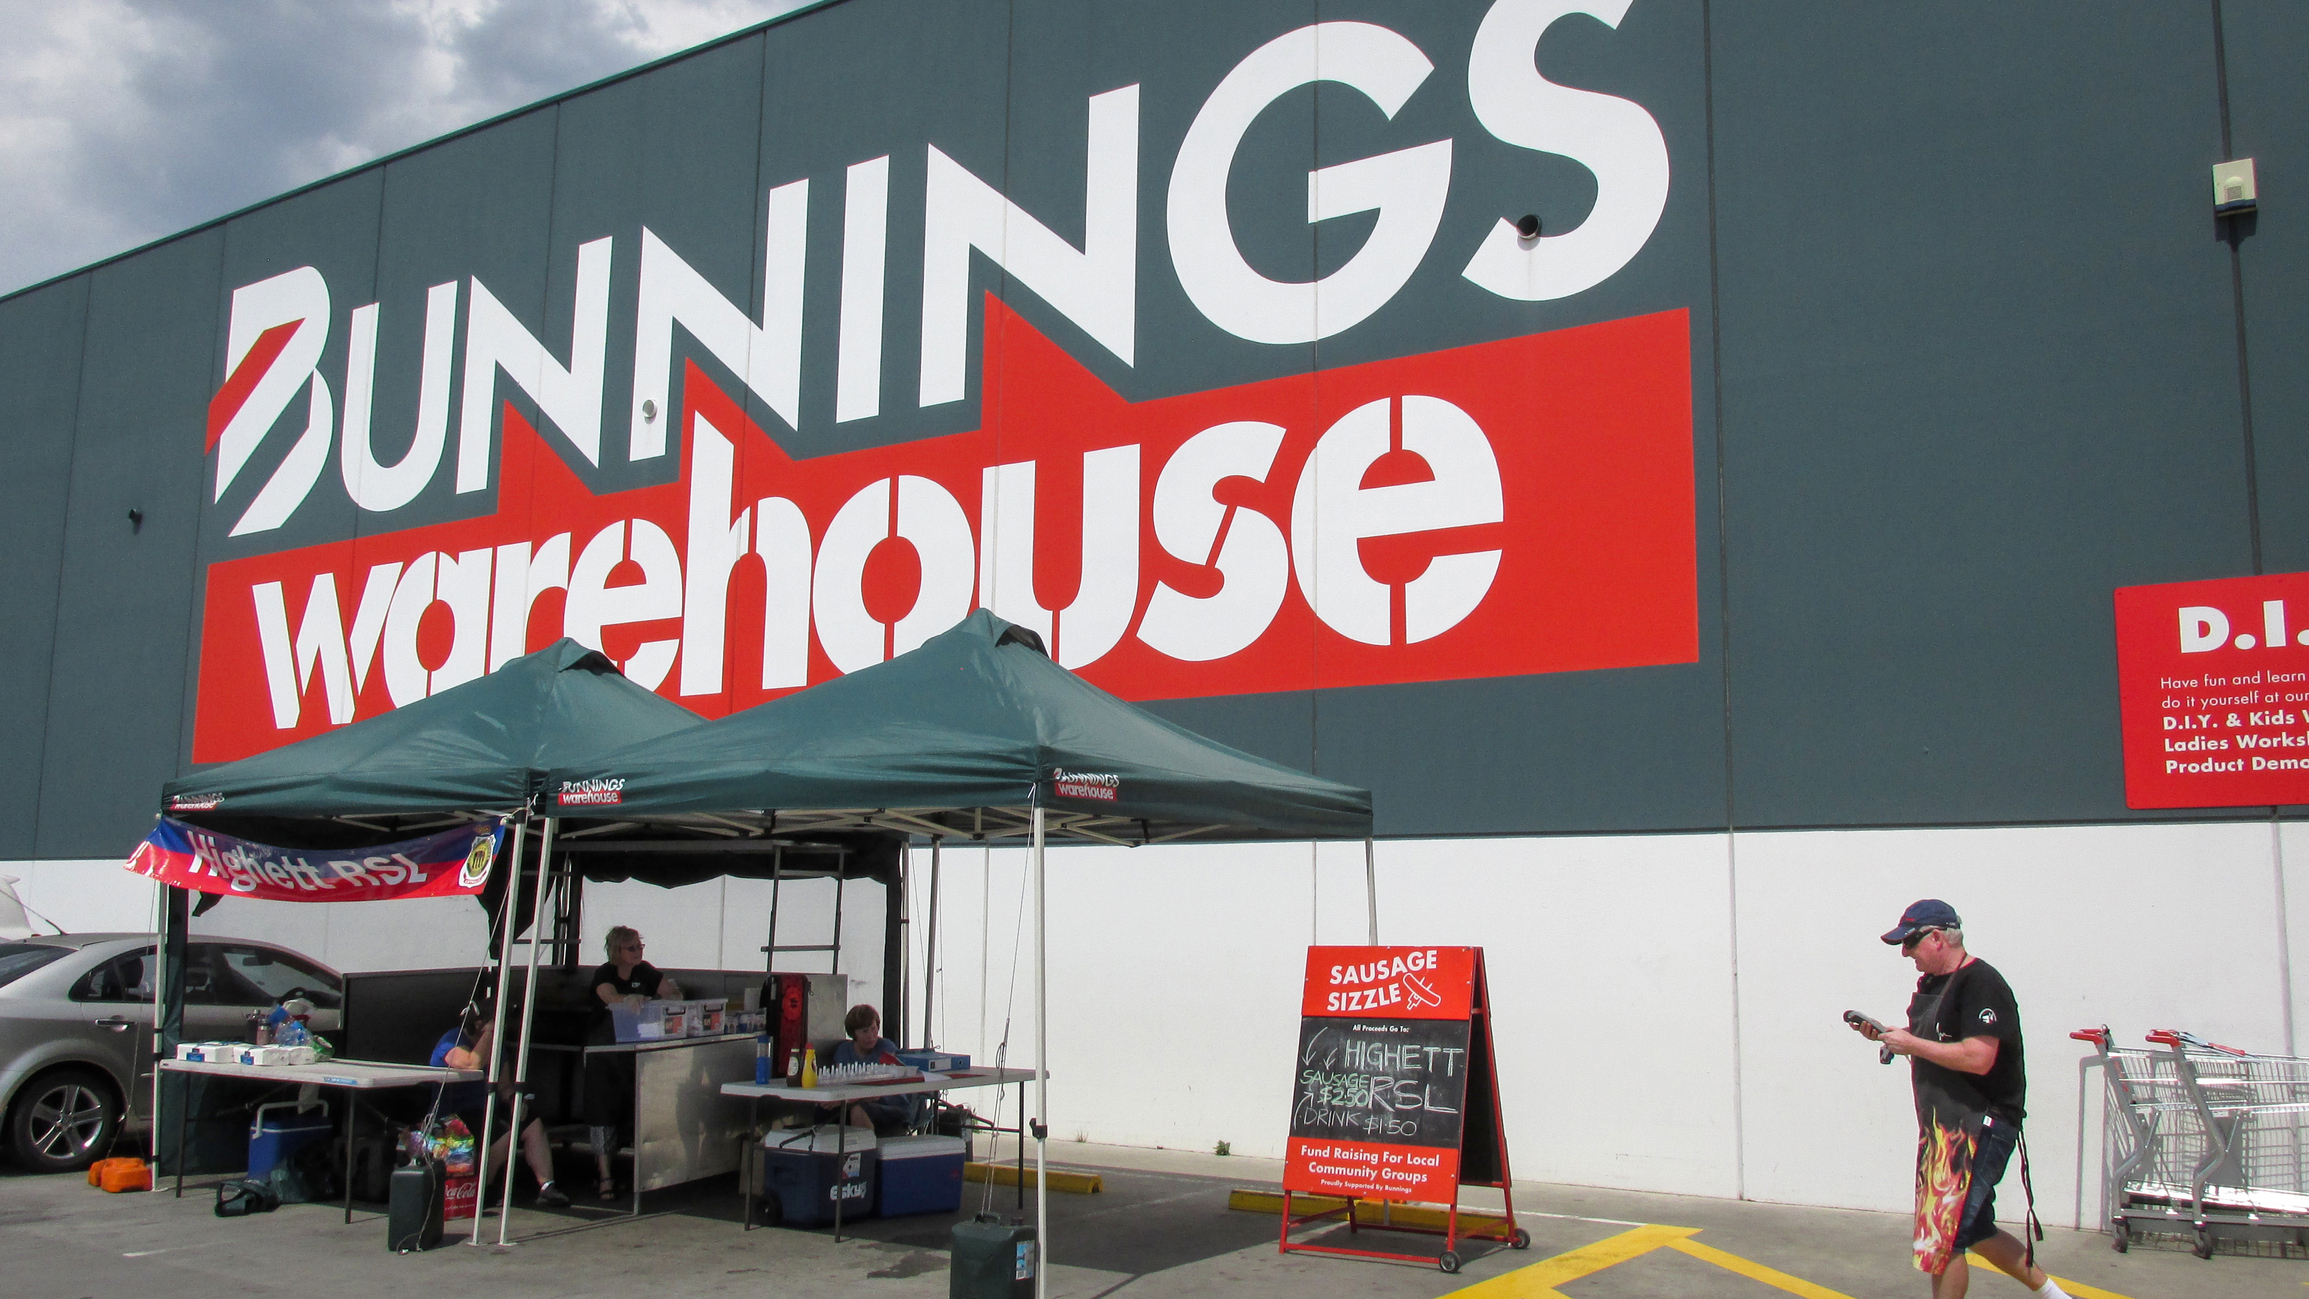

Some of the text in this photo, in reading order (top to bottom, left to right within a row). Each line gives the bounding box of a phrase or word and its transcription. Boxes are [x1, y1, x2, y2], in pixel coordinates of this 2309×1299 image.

[206, 0, 1669, 537] BUNNINGS
[252, 395, 1504, 729] warehouse
[2160, 670, 2306, 689] Have fun and learn
[2162, 695, 2181, 709] do
[2186, 696, 2195, 707] it
[2200, 690, 2259, 710] yourself
[2264, 691, 2279, 703] at
[2163, 714, 2218, 730] D.I.Y.
[2226, 713, 2242, 727] &
[2249, 709, 2295, 726] Kids
[2164, 736, 2229, 752] Ladies
[2165, 757, 2244, 774] Product
[562, 789, 619, 804] warehouse
[1058, 783, 1114, 799] warehouse
[186, 830, 337, 892] Highett
[327, 853, 428, 887] RSL
[1329, 949, 1438, 985] SAUSAGE
[1327, 983, 1402, 1012] SIZZLE
[1389, 1025, 1399, 1033] Go
[1344, 1039, 1464, 1077] HIGHETT
[1300, 1069, 1370, 1090] SAUSAGE
[1368, 1076, 1459, 1114] RSL
[1303, 1107, 1362, 1128] DRINK
[1301, 1145, 1440, 1167] Fund Raising For Local
[1308, 1162, 1428, 1184] Community Groups
[1320, 1179, 1412, 1193] Proudly Supported By Bunnings
